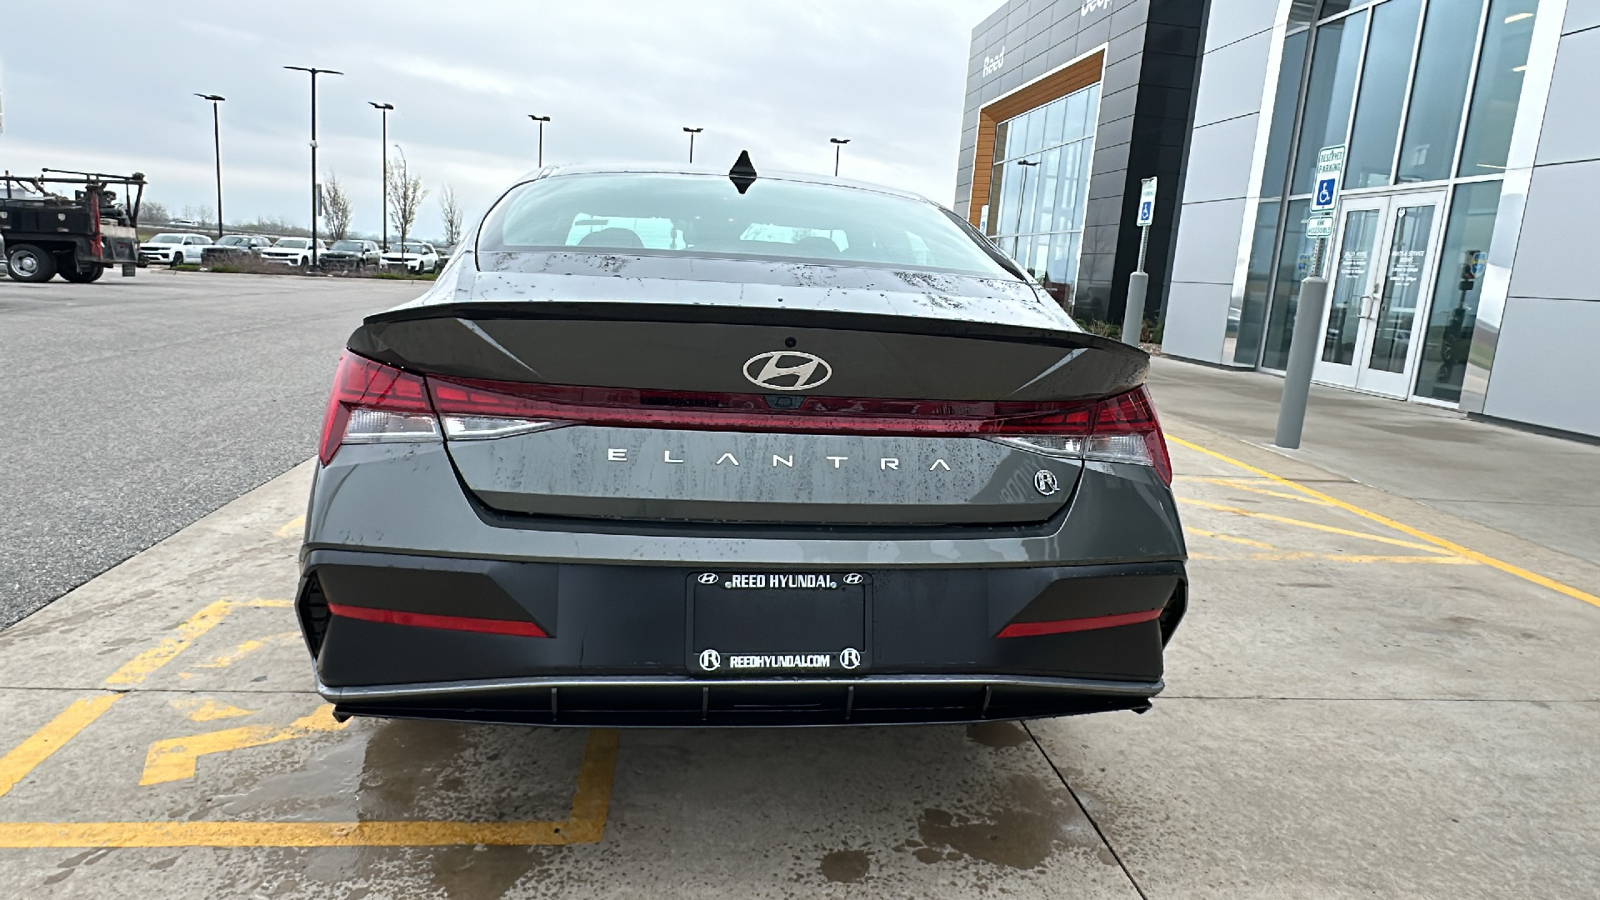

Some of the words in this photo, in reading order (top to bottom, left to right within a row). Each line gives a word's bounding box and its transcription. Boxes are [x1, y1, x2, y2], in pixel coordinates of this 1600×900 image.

[983, 45, 1005, 78] Reed
[607, 447, 951, 472] ELANTRA
[731, 574, 766, 588] REED
[769, 574, 831, 588] HYUNDAI
